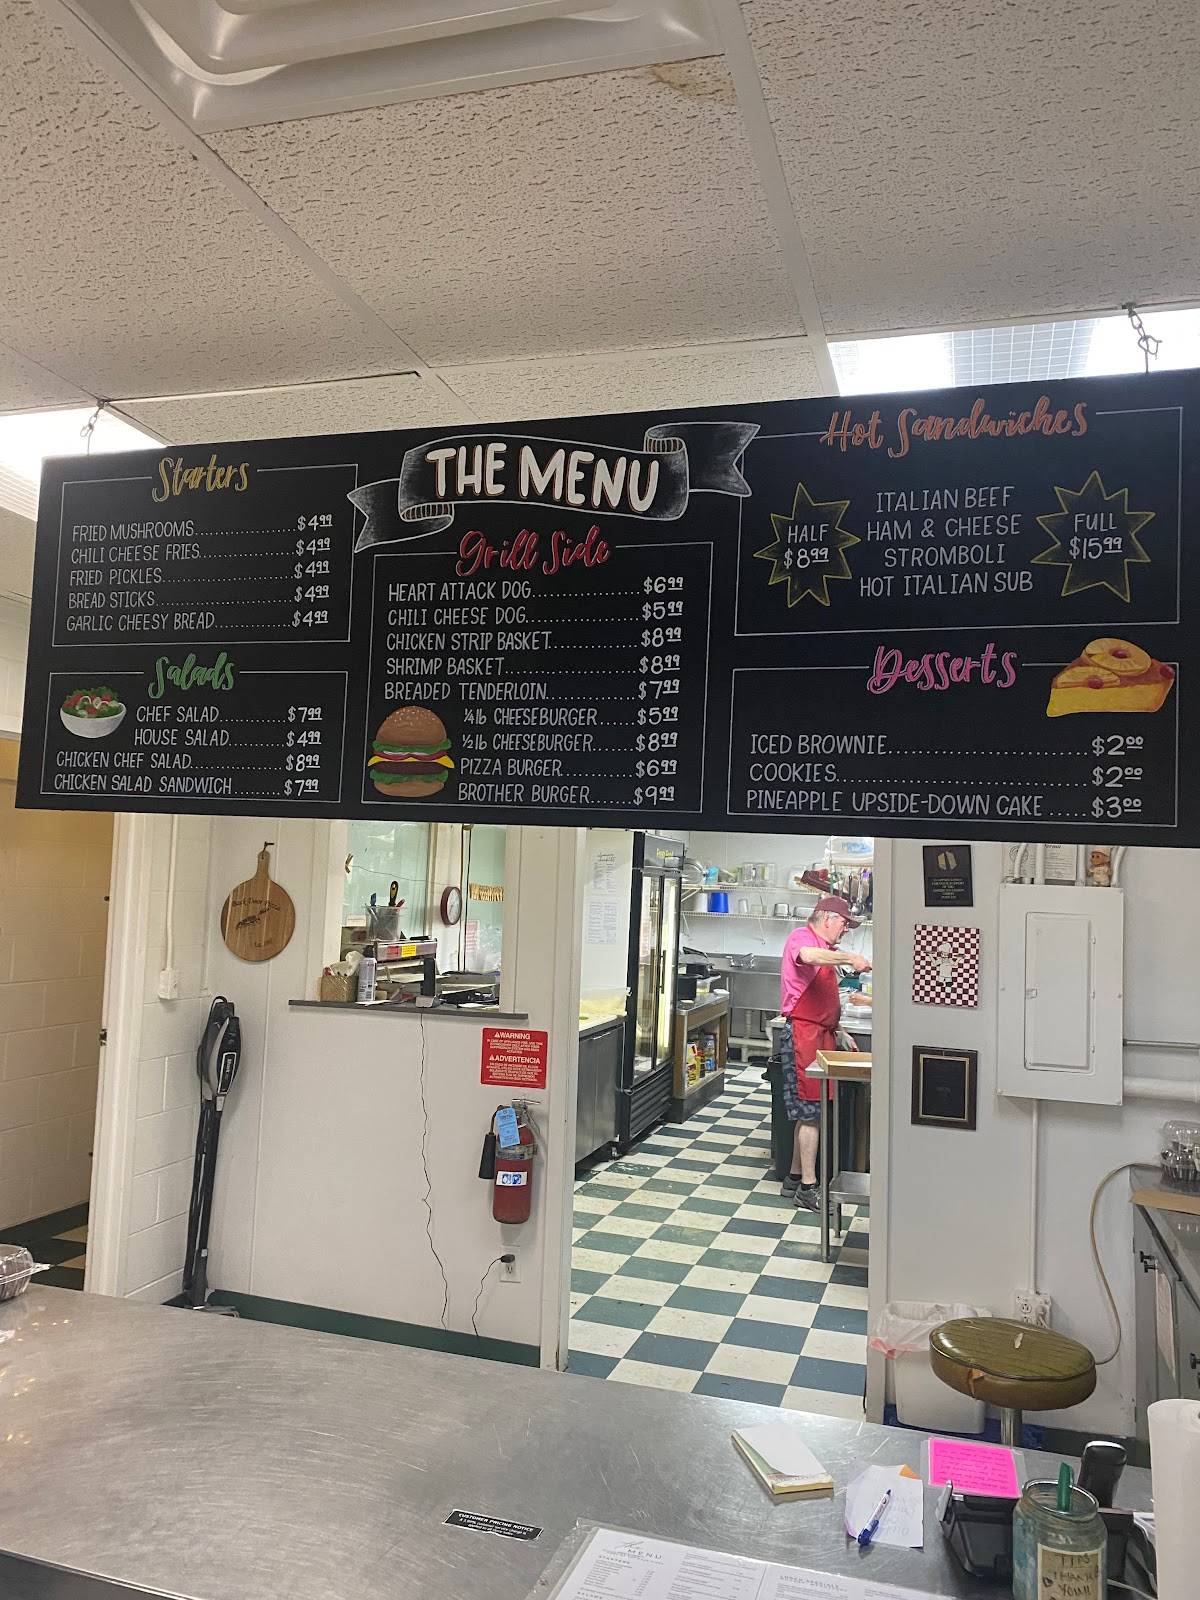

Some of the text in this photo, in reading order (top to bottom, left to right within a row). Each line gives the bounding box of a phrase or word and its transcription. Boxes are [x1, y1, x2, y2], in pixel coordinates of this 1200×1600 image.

[819, 395, 1088, 459] Hot Sandwiches
[152, 454, 250, 502] Starters
[425, 442, 660, 513] THE MENU
[876, 485, 1015, 513] ITALIAN BEEF
[72, 525, 107, 542] FRIED
[110, 520, 195, 540] MUSHROOMS
[867, 514, 1022, 542] HAM & CHEESE
[1074, 513, 1117, 532] FULL
[787, 524, 829, 543] HALF
[71, 547, 104, 564] CHILI
[108, 545, 159, 561] CHEESE
[165, 543, 200, 560] FRIES
[455, 524, 610, 577] Grill Side
[884, 544, 1005, 568] STROMBOLI
[69, 569, 103, 586] FRIED
[109, 568, 163, 585] PICKLES
[859, 571, 1033, 597] HOT ITALIAN SUB
[68, 592, 106, 609] BREAD
[109, 591, 155, 608] STICKS
[388, 583, 436, 602] HEART
[440, 581, 495, 600] ATTACK
[501, 581, 532, 599] DOG
[66, 615, 113, 632] GARLIC
[118, 613, 169, 631] CHEESY
[173, 612, 215, 629] BREAD
[388, 609, 427, 626] CHILI
[433, 607, 489, 625] CHEESE
[495, 606, 527, 624] DOG
[386, 633, 446, 651] CHICKEN
[450, 632, 493, 651] STRIP
[497, 631, 552, 650] BASKET
[148, 652, 235, 699] Salads
[386, 658, 445, 675] SHRIMP
[448, 657, 505, 675] BASKET
[866, 642, 1018, 695] Desserts
[384, 682, 451, 700] BREADED
[459, 682, 547, 700] TENDERLOIN
[136, 706, 171, 722] CHEF
[177, 706, 220, 722] SALAD
[493, 708, 598, 726] CHEESEBURGER
[134, 728, 178, 746] HOUSE
[184, 729, 230, 746] SALAD
[492, 734, 593, 752] CHEESEBURGER
[750, 733, 791, 755] ICED
[797, 735, 887, 755] BROWNIE
[56, 751, 109, 768] CHICKEN
[113, 752, 144, 769] CHEF
[150, 753, 192, 769] SALAD
[460, 758, 502, 776] PIZZA
[507, 759, 562, 777] BURGER
[749, 762, 837, 783] COOKIES
[54, 775, 107, 791] CHICKEN
[111, 775, 152, 792] SALAD
[158, 776, 232, 795] SANDWICH
[458, 783, 524, 803] BROTHER
[531, 785, 590, 804] BURGER
[746, 790, 842, 812] PINEAPPLE
[852, 792, 989, 816] UPSIDE-DOWN
[996, 795, 1042, 817] CAKE
[494, 1055, 541, 1063] ADVERTENCIA
[458, 1513, 488, 1523] CUSTOMER
[489, 1519, 512, 1528] PRICING
[513, 1524, 534, 1533] NOTICE
[1055, 1553, 1090, 1567] TIPS
